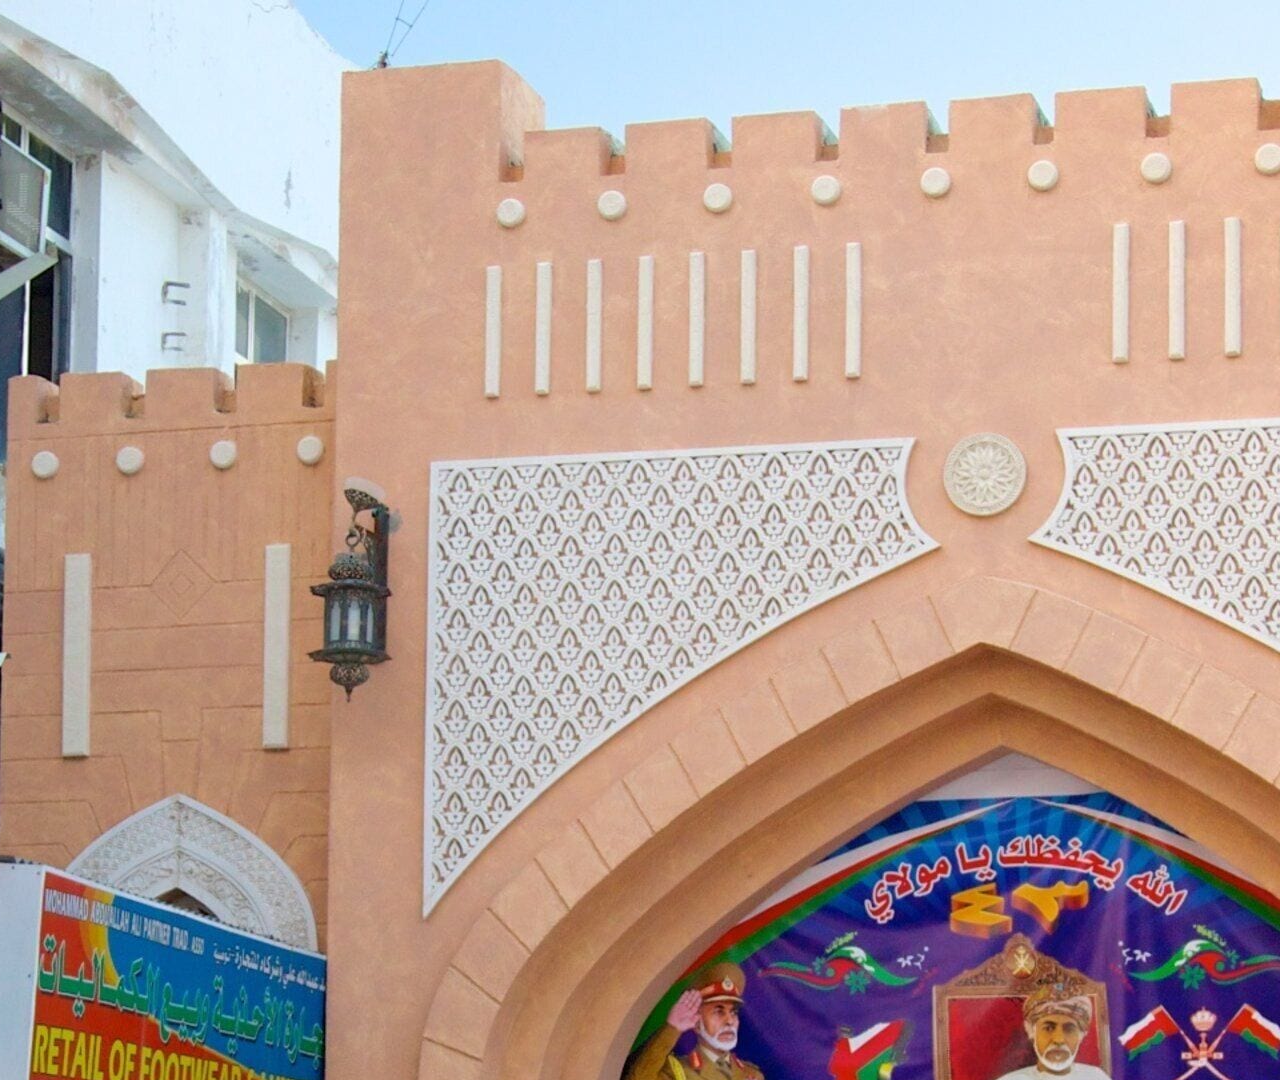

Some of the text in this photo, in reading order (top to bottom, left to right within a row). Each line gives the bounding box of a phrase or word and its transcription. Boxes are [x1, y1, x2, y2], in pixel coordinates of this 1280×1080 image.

[864, 835, 1189, 924] الله يحفظك يا مولاي
[38, 933, 161, 1020] الكماليات
[159, 981, 211, 1045] وبيع
